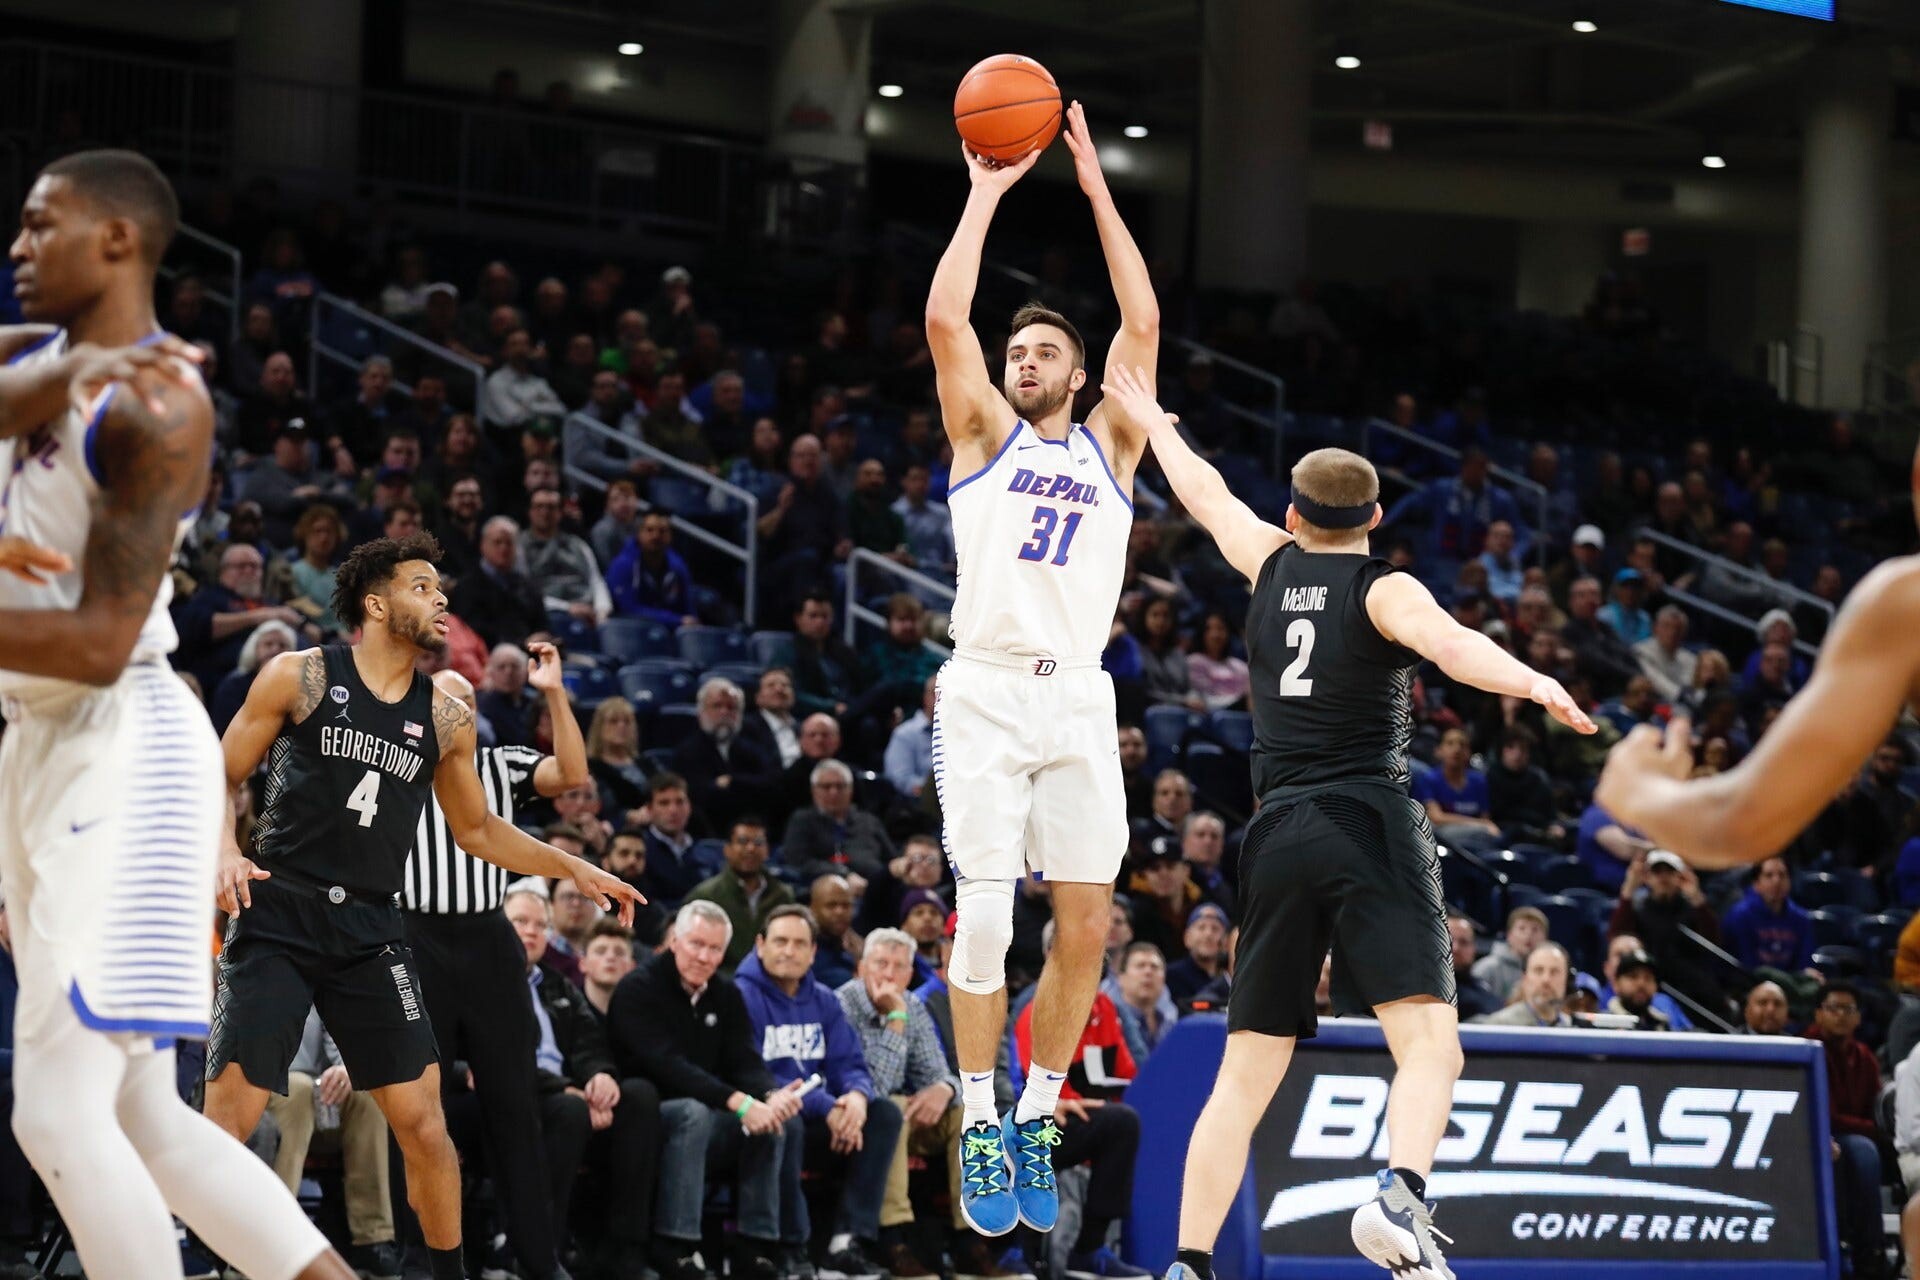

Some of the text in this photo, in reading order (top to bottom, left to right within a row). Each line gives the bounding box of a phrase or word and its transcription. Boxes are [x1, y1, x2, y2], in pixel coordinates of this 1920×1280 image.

[1017, 505, 1084, 567] 31
[1280, 618, 1316, 697] 2
[320, 725, 424, 783] GEORGETOWN
[346, 769, 381, 828] 4
[390, 963, 421, 1021] GEORGETOWN
[1511, 1212, 1776, 1243] CONFERENCE
